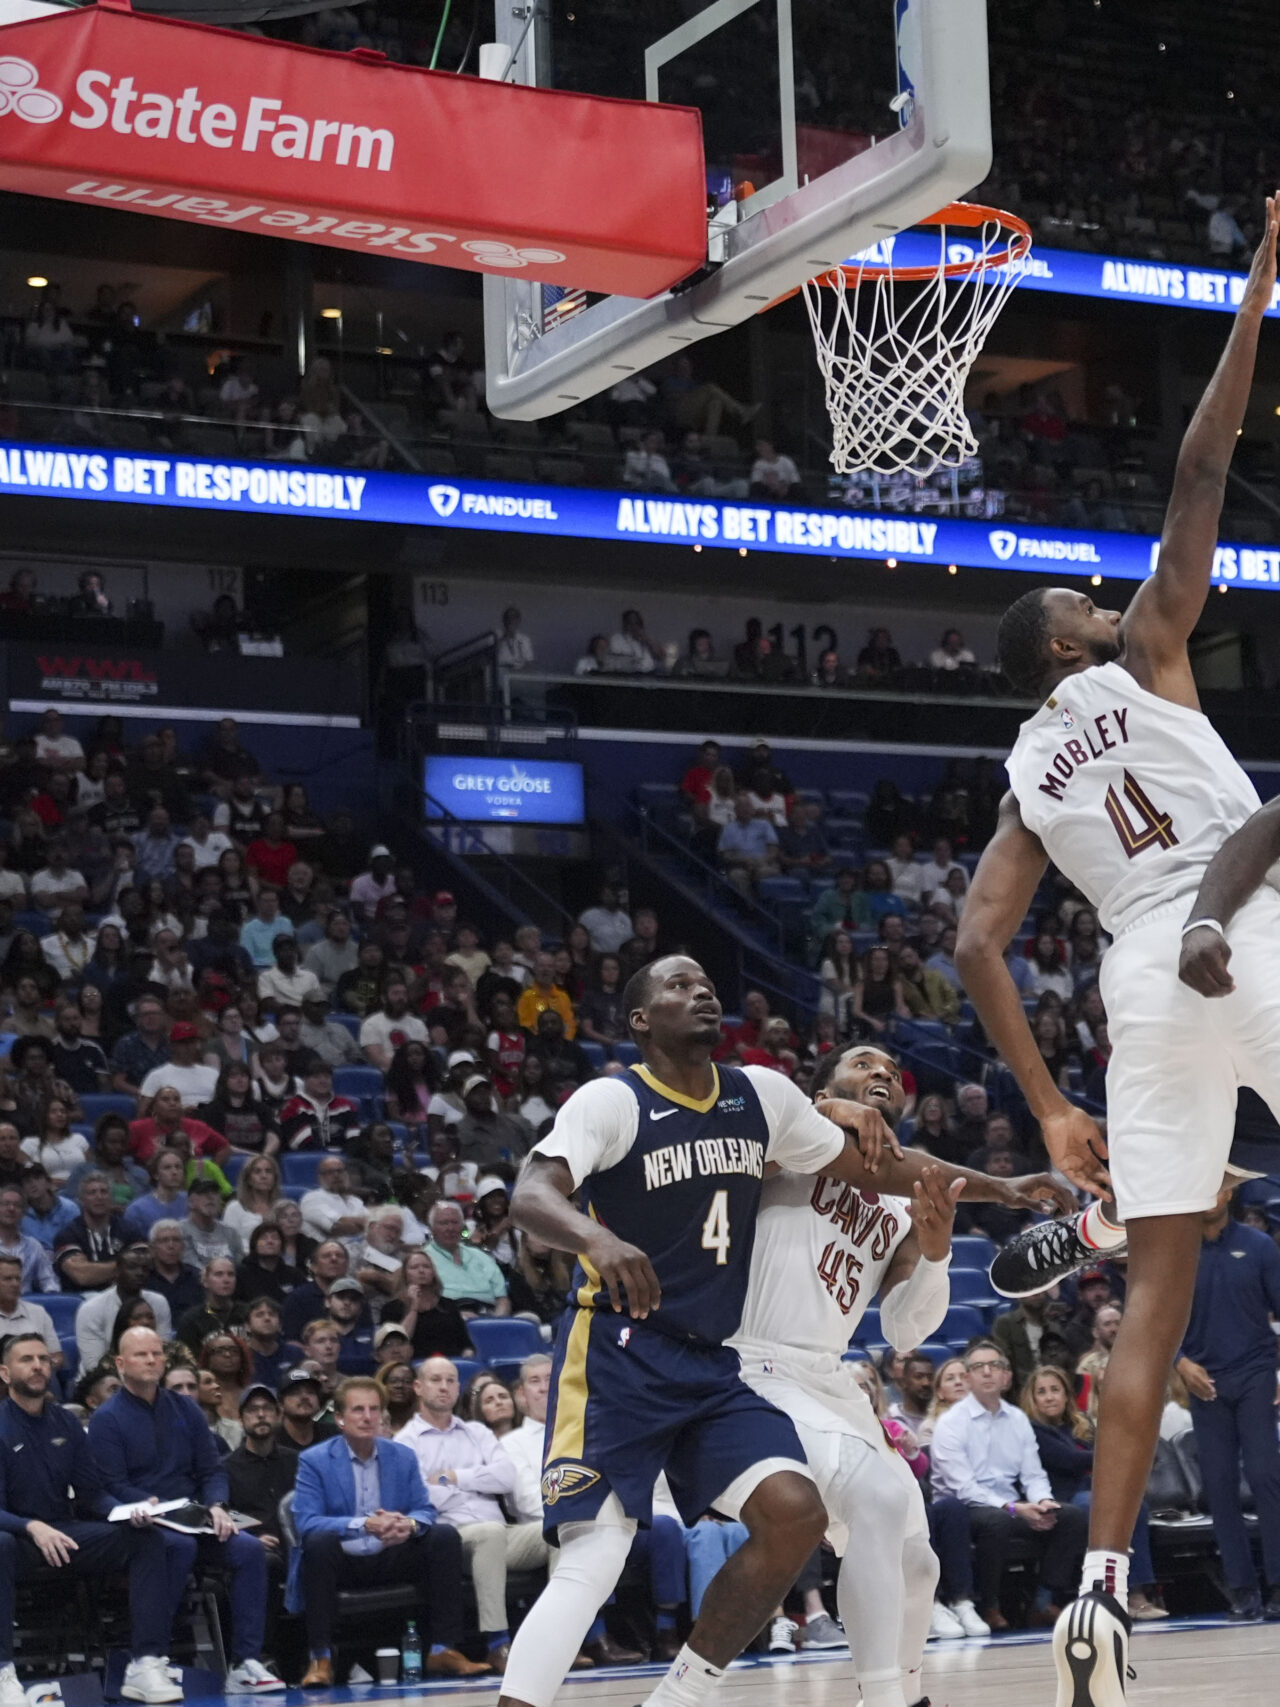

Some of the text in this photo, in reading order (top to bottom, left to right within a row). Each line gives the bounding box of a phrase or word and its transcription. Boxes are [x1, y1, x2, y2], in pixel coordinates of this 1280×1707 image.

[1101, 260, 1184, 299] ALWAYS
[1186, 271, 1227, 303] BET
[114, 457, 170, 496] BET
[176, 462, 366, 511] RESPONSIBLY
[461, 493, 558, 520] FANDUEL
[616, 498, 938, 555] ALWAYS BET RESPONSIBLY
[1017, 537, 1101, 563] FANDUEL
[1038, 707, 1128, 802] MOBLEY
[452, 774, 551, 794] GREY GOOSE
[486, 796, 522, 806] VODKA
[1104, 767, 1180, 860] 4
[643, 1138, 764, 1191] NEW ORLEANS
[702, 1190, 731, 1265] 4
[809, 1175, 899, 1262] CAVS
[816, 1240, 864, 1315] 45
